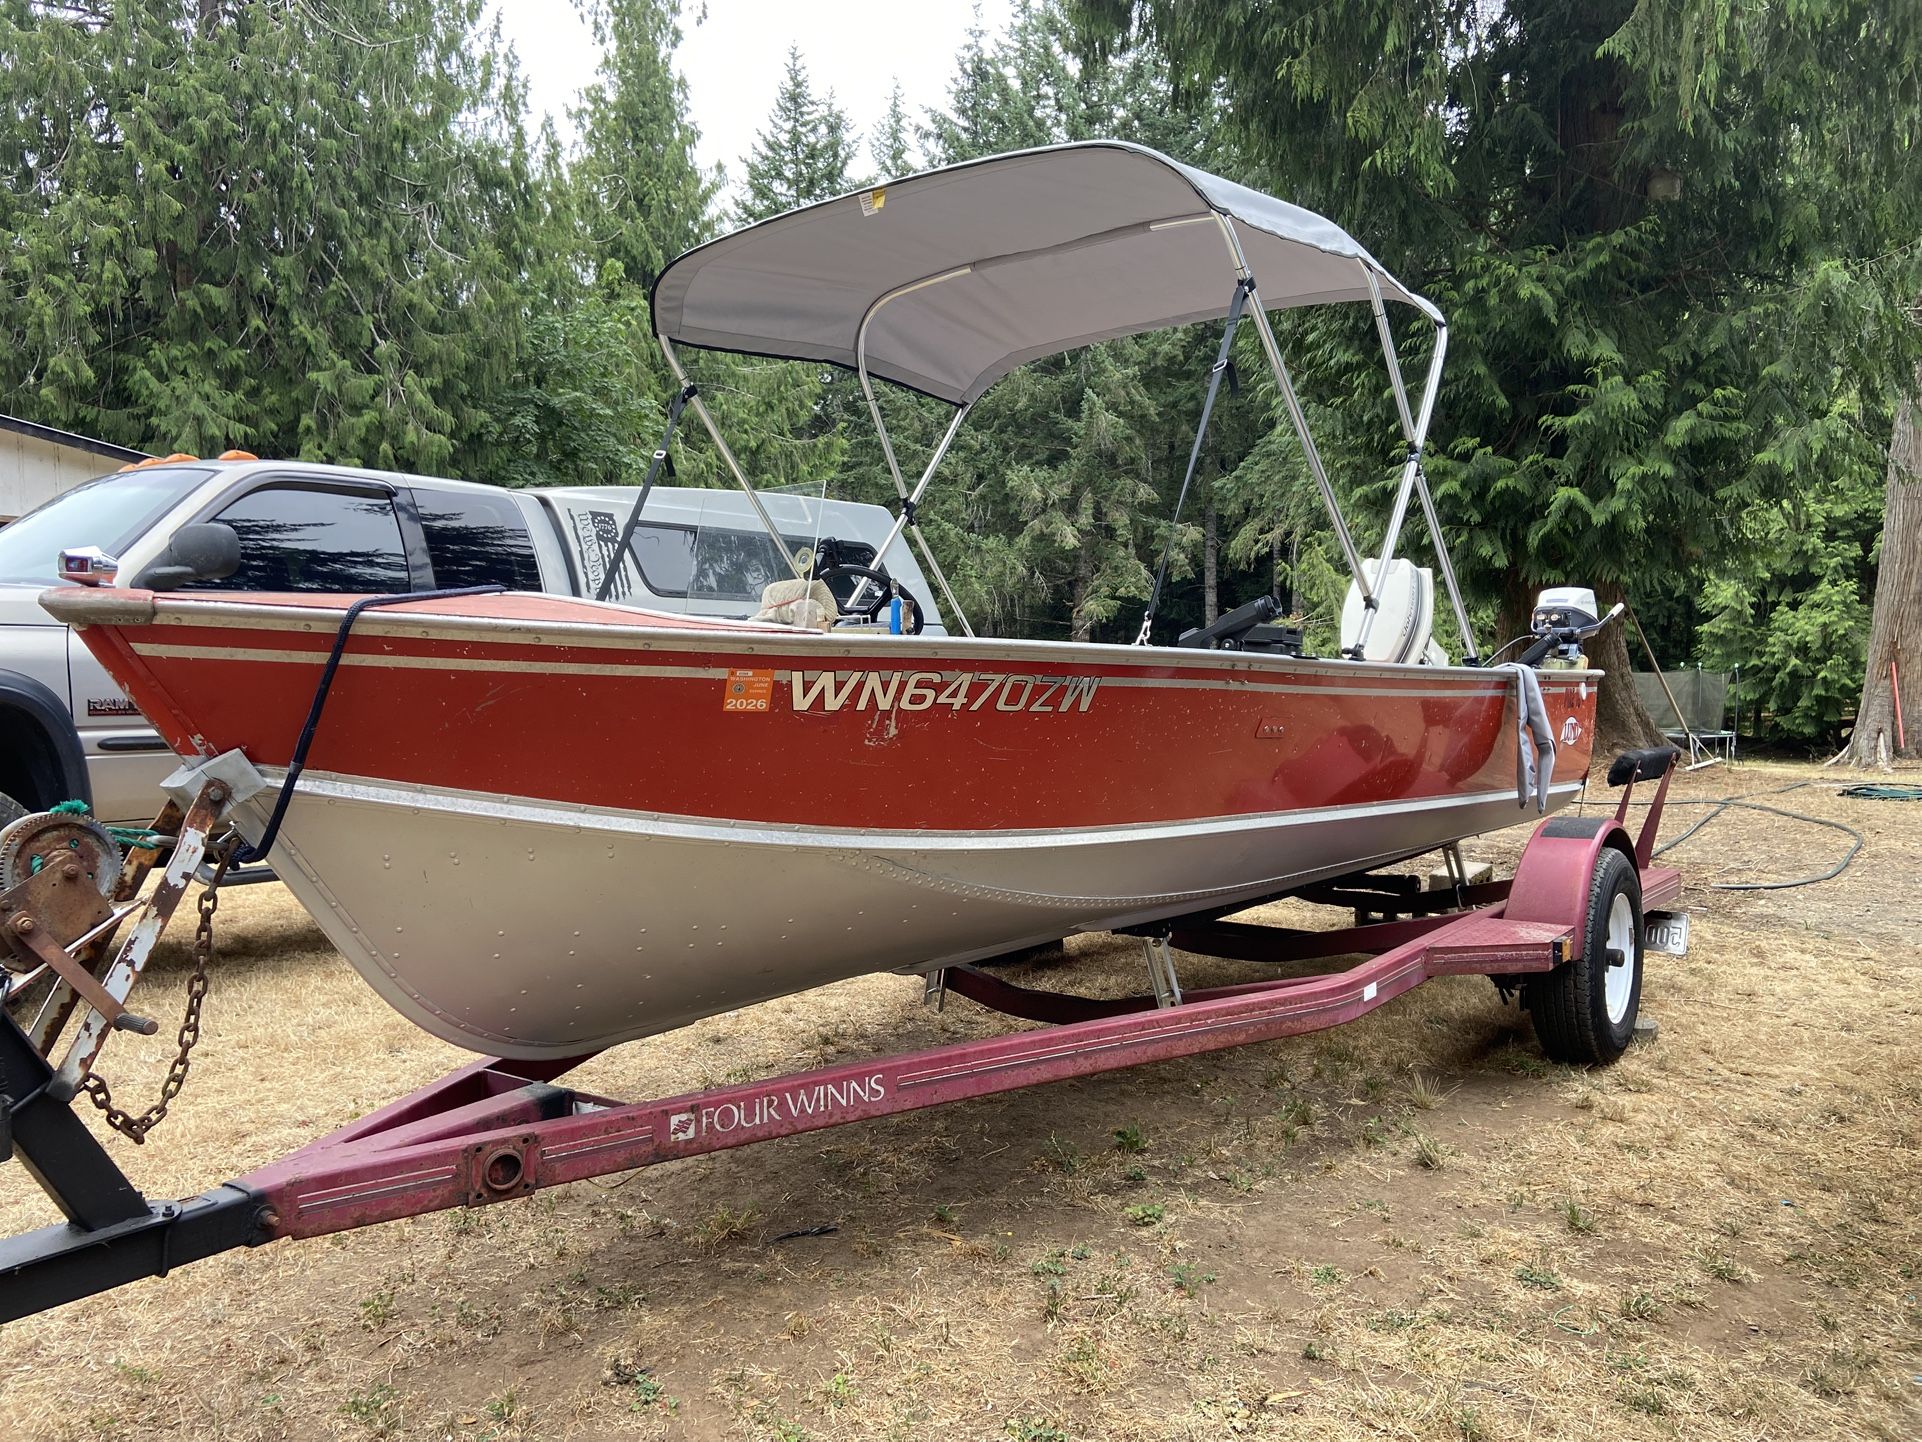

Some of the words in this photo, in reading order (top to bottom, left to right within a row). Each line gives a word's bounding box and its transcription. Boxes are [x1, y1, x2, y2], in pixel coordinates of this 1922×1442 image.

[578, 512, 592, 534] We
[89, 698, 129, 709] RAM
[725, 698, 767, 710] 2026
[702, 1095, 782, 1136] FOUR
[785, 1074, 885, 1118] WINNS
